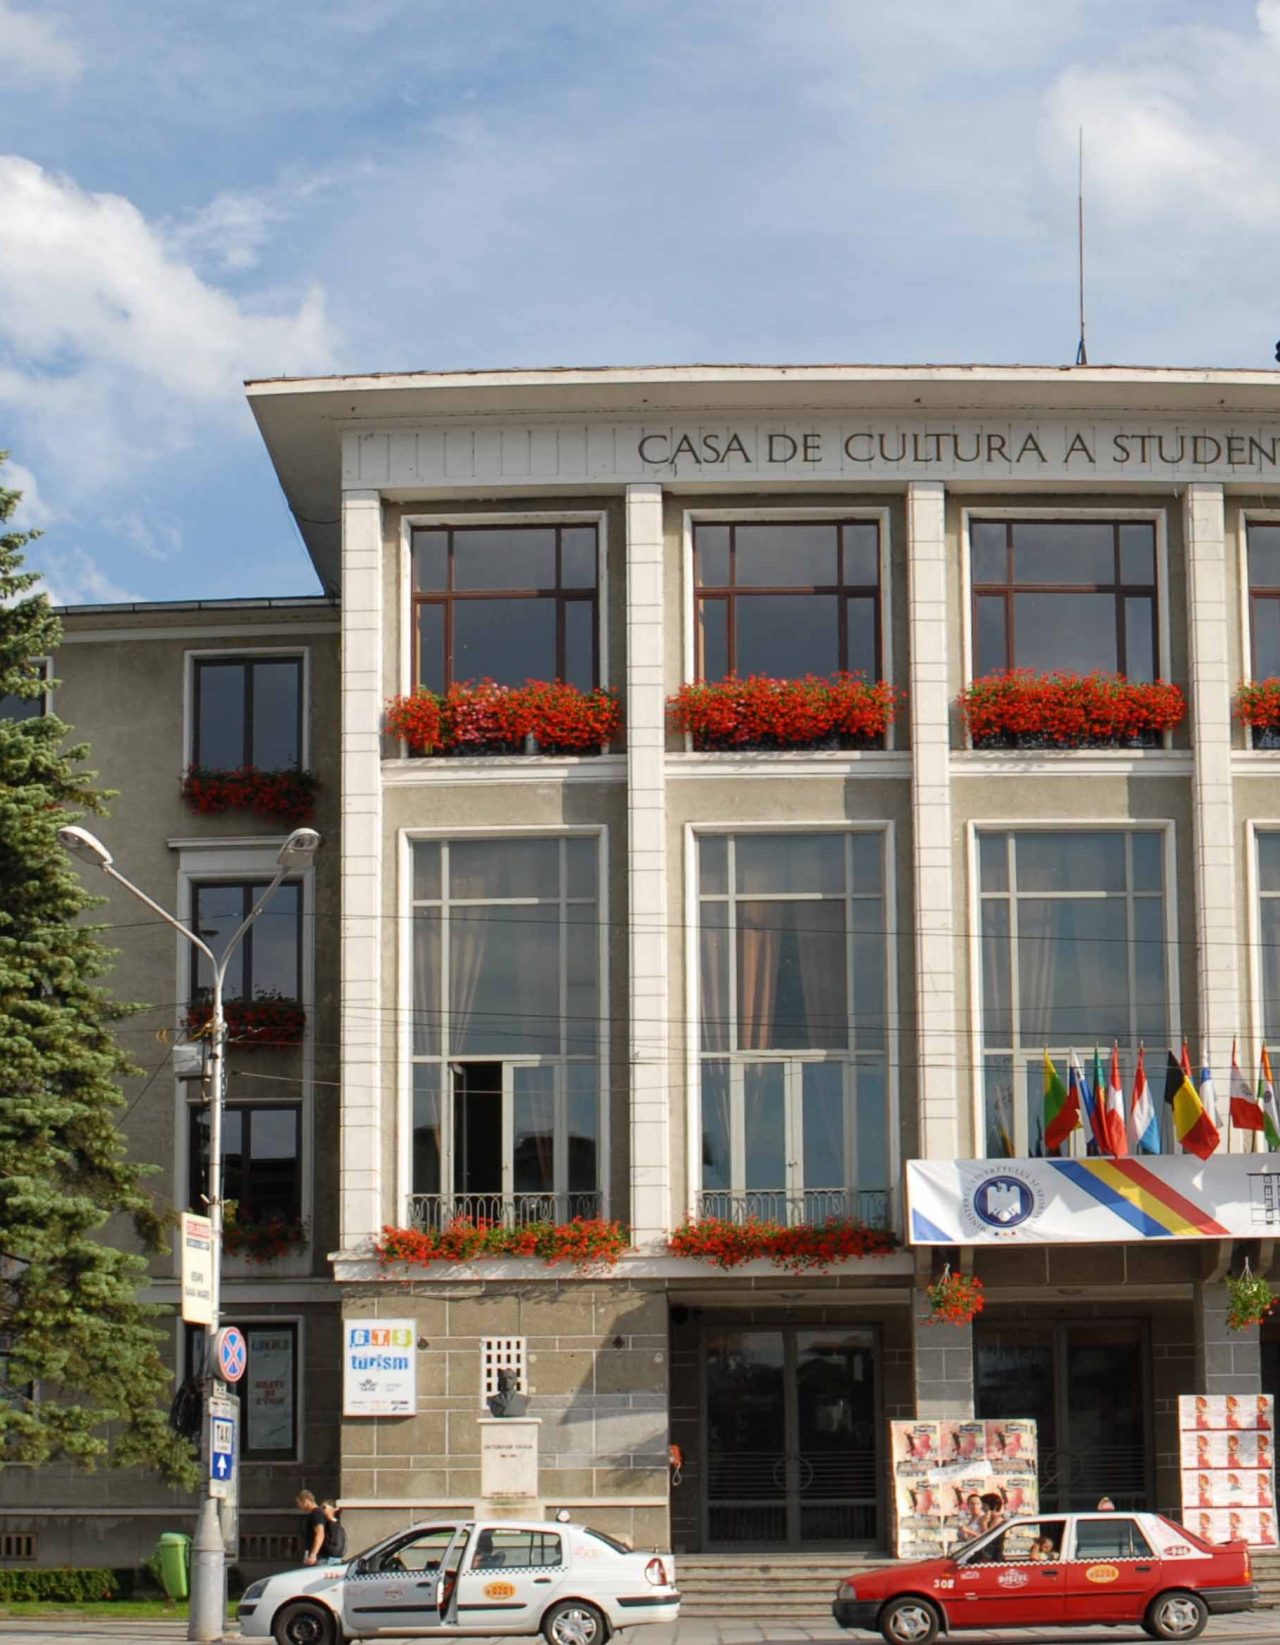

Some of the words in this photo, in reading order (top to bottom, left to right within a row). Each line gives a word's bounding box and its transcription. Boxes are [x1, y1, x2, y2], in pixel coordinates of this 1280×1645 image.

[637, 433, 752, 464] CASA
[767, 433, 824, 463] DE
[844, 433, 1047, 463] CULTURA
[1063, 433, 1096, 463] A
[351, 1354, 409, 1371] turism
